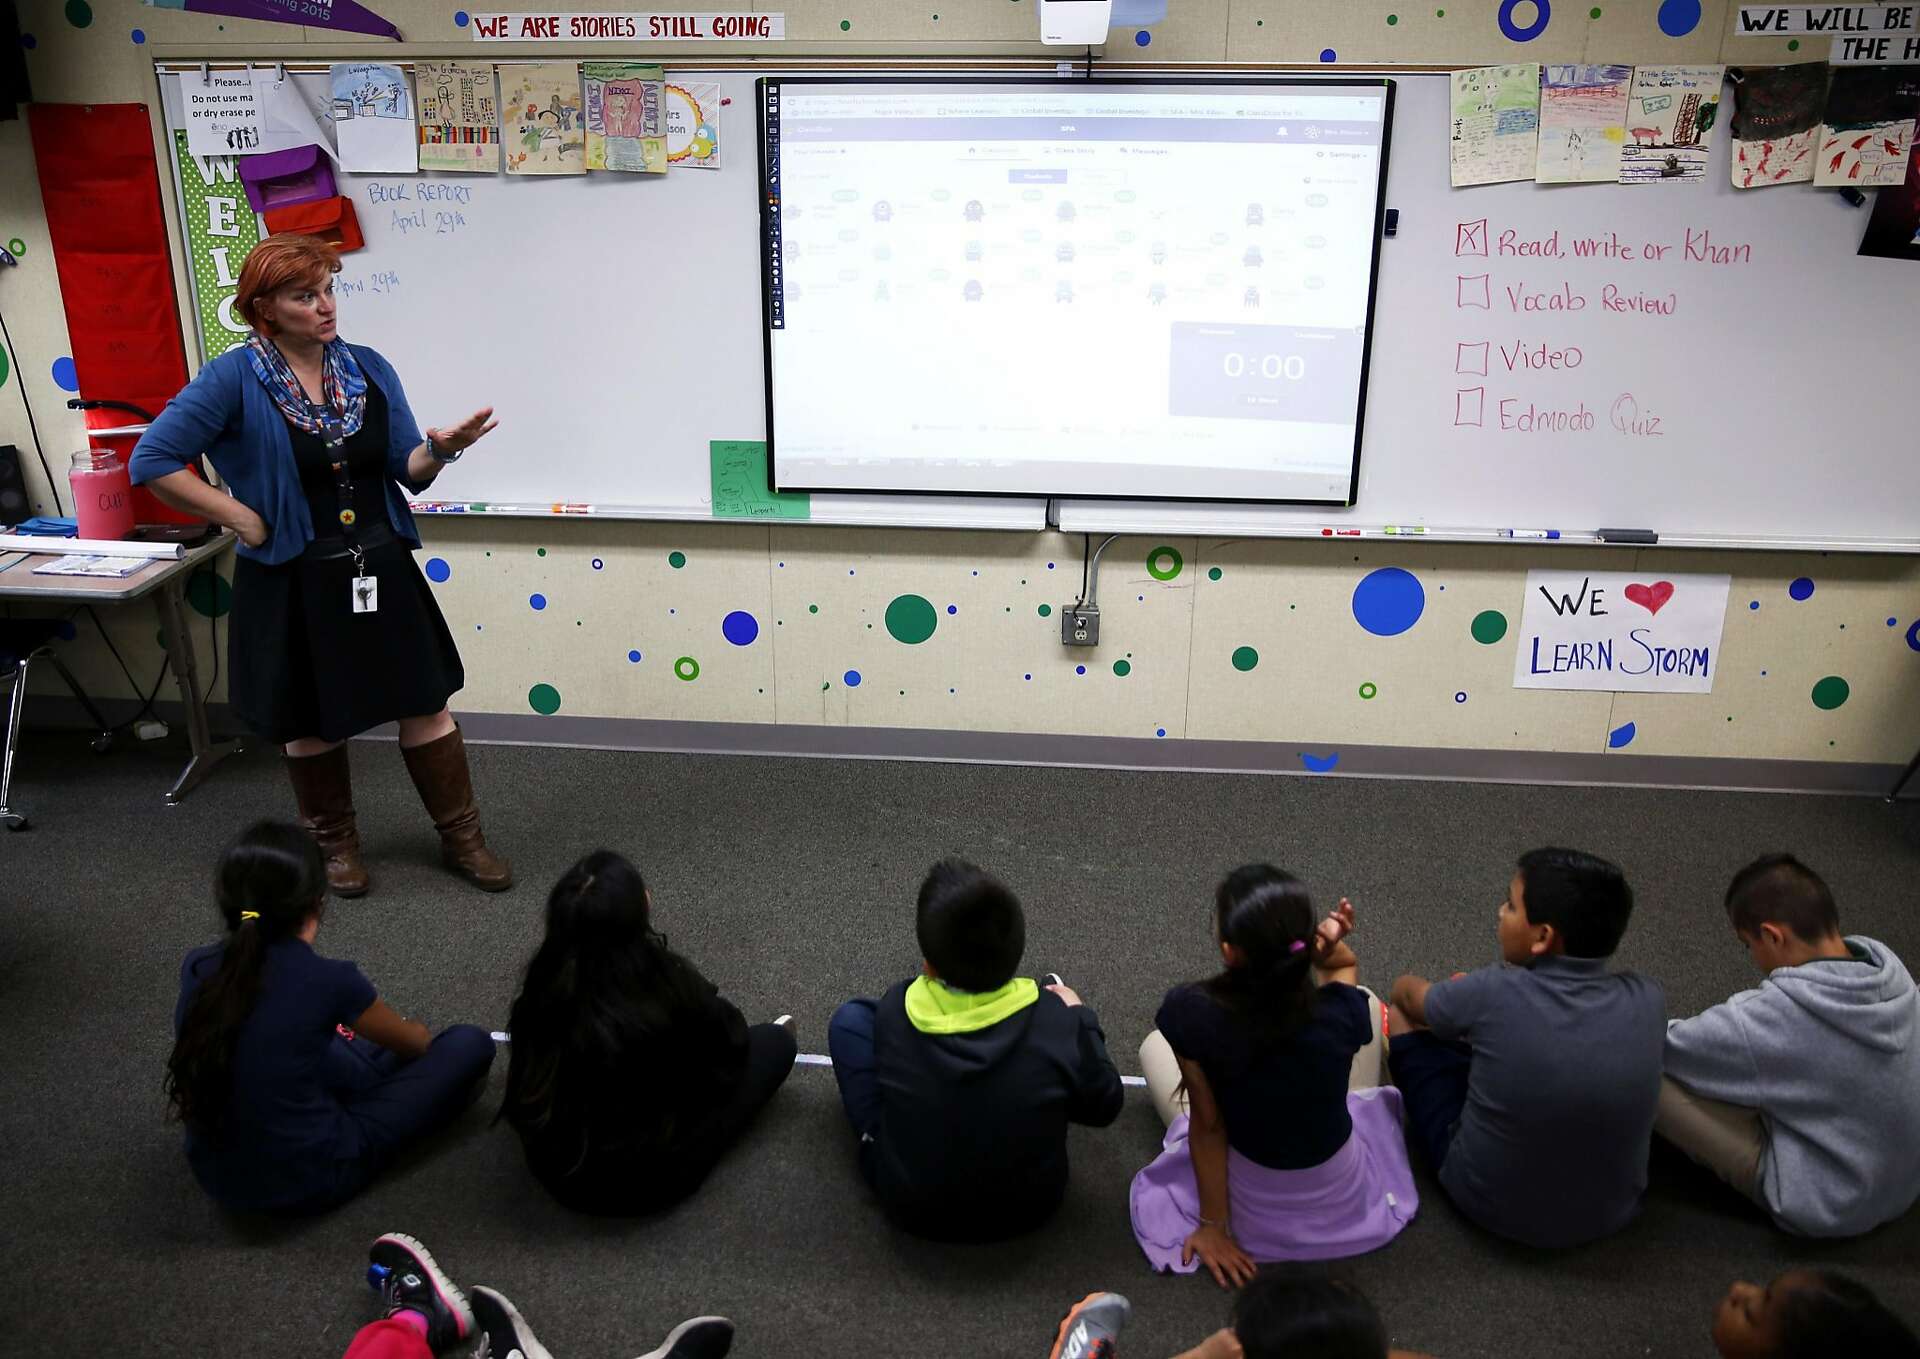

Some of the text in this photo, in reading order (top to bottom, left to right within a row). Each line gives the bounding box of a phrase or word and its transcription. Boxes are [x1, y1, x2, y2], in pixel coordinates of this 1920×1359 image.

[301, 2, 331, 20] 2015
[1741, 7, 1912, 31] WE WILL BE
[474, 16, 770, 38] WE ARE STORIES STILL GOING
[1843, 38, 1890, 60] THE
[192, 95, 204, 103] Do
[204, 109, 218, 118] dry
[416, 182, 472, 204] REPORT
[392, 208, 426, 233] April
[1498, 228, 1751, 264] Read, write or Khan
[1506, 282, 1676, 315] Vocab Review
[1224, 353, 1305, 380] 0:00
[1500, 339, 1583, 371] Video
[1500, 392, 1664, 436] Edmodo Quiz
[1539, 577, 1608, 616] WE
[1530, 628, 1708, 678] LEARN STORM
